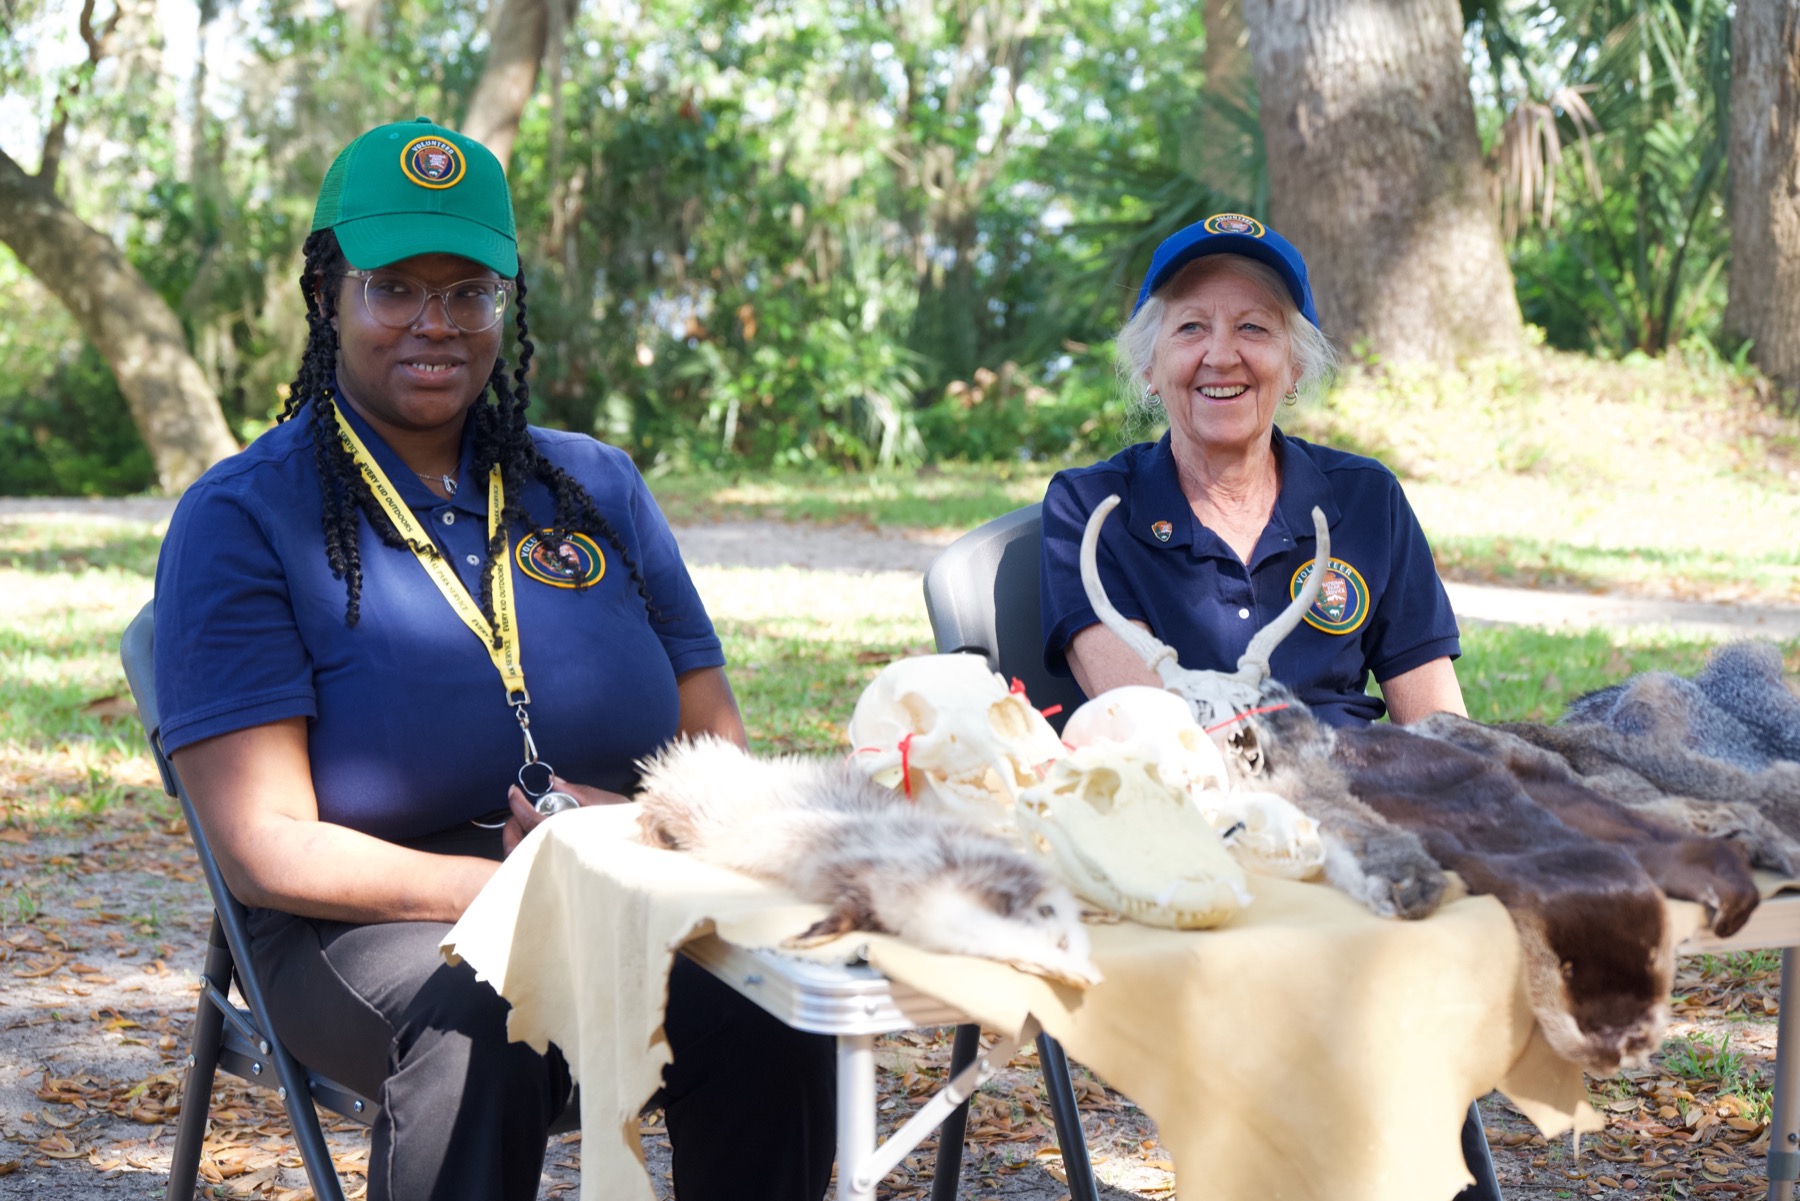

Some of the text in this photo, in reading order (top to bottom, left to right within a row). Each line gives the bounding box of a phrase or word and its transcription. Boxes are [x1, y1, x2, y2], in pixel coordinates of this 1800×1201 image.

[411, 140, 455, 155] VOLUNTEER
[1214, 215, 1254, 225] VOLUNTEER
[340, 430, 360, 456] SERVICE
[361, 462, 413, 533] EVERY KID OUTDOORS
[498, 563, 507, 598] OUTDOORS
[1296, 561, 1352, 584] VOLTEER
[501, 613, 510, 632] EVERY
